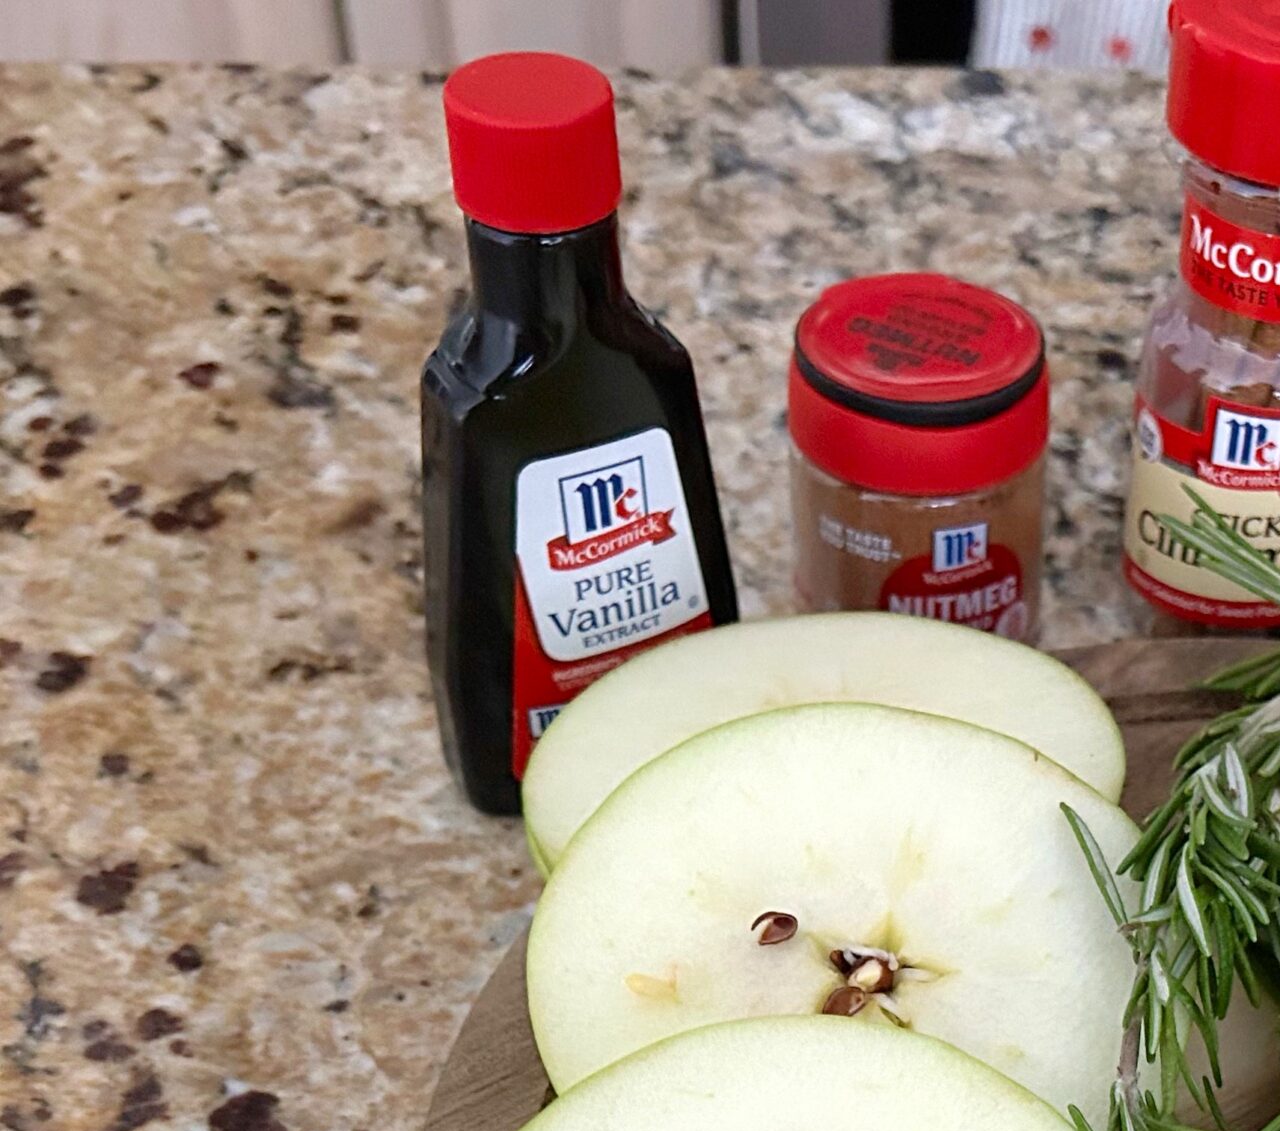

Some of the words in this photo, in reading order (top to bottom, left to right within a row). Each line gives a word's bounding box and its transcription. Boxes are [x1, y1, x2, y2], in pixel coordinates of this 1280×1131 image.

[1218, 276, 1268, 306] TASTE
[554, 518, 664, 567] McCormick
[575, 559, 654, 601] PURE
[548, 580, 681, 638] Vanilla
[582, 613, 663, 648] EXTRACT
